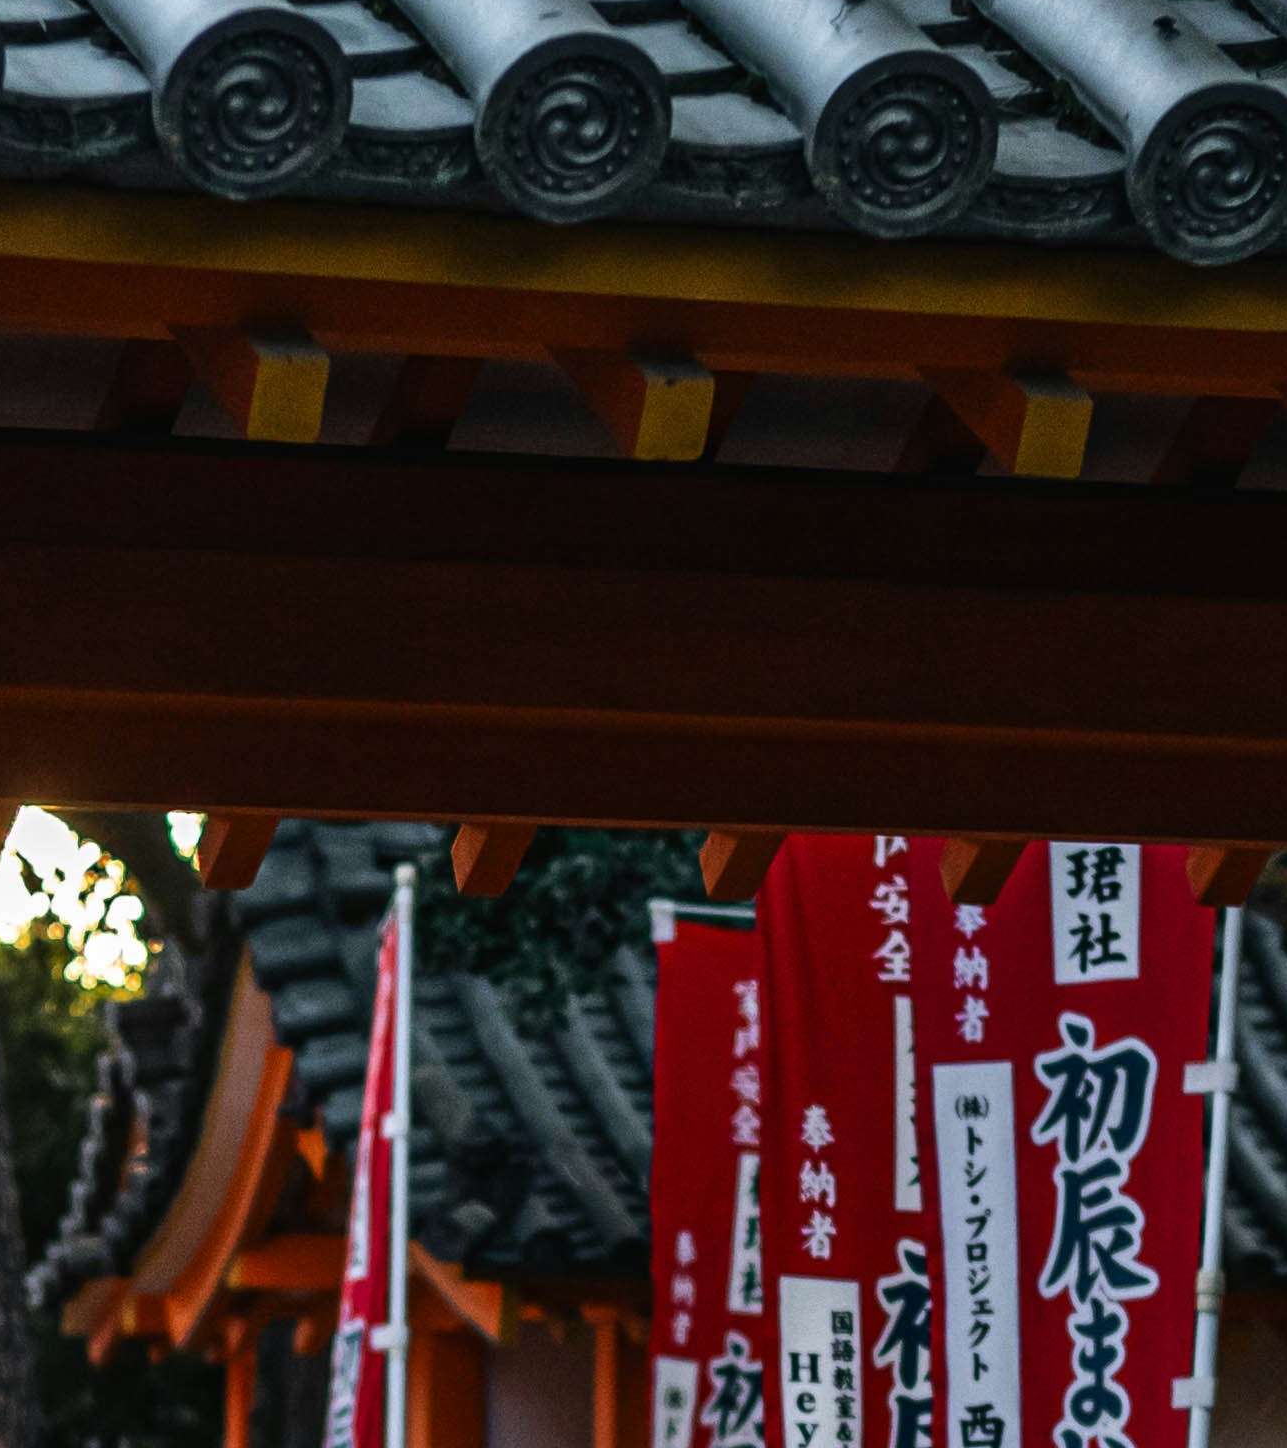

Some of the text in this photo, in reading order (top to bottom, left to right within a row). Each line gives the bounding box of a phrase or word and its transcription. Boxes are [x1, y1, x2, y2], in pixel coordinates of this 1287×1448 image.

[954, 904, 989, 1043] 奉納者
[799, 1105, 837, 1260] 奉納者
